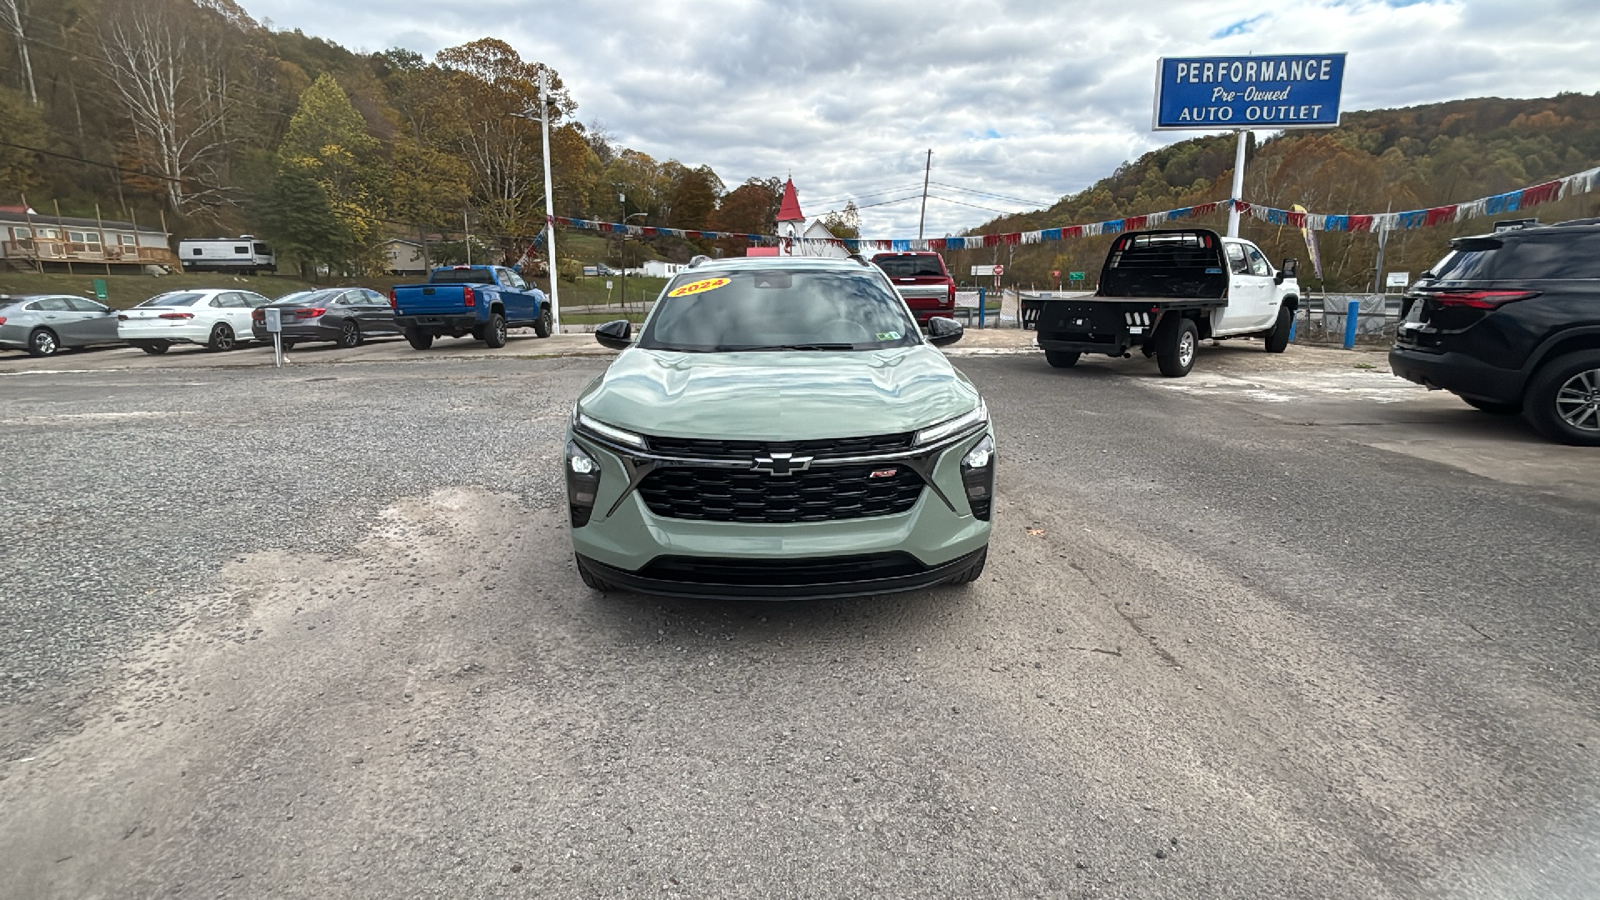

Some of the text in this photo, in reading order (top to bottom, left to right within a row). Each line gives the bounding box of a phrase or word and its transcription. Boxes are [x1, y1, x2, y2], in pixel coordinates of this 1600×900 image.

[1177, 60, 1332, 83] PERFORMANCE
[1211, 86, 1291, 102] Pre-Owned
[1179, 105, 1322, 121] AUTO OUTLET
[675, 279, 724, 296] 2024
